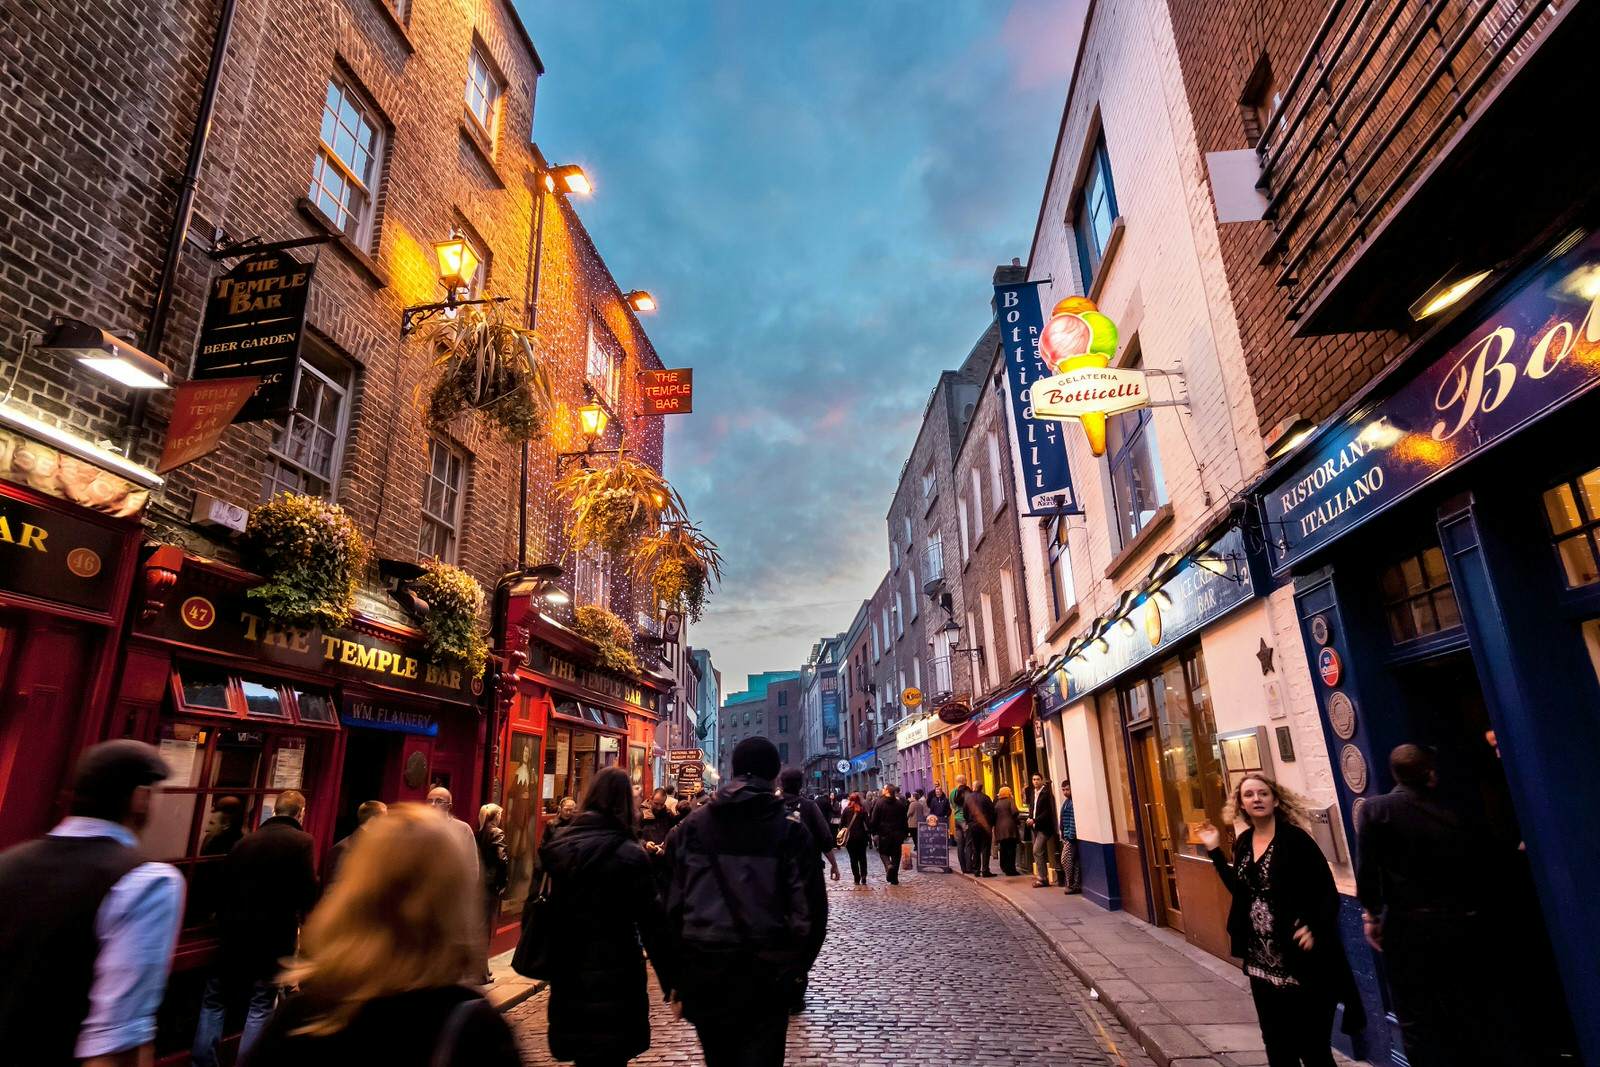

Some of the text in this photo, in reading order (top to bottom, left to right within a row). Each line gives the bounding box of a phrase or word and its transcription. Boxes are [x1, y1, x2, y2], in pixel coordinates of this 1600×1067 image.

[246, 259, 280, 273] THE
[217, 273, 307, 299] TEMPLE
[229, 294, 283, 315] BAR
[203, 333, 297, 355] BEER GARDEN
[655, 372, 678, 383] THE
[1058, 373, 1118, 387] GELATERIA
[645, 384, 691, 397] TEMPLE
[1003, 291, 1045, 488] Botticelli
[1043, 383, 1140, 404] Botticelli
[655, 398, 679, 409] BAR
[1300, 466, 1384, 538] ITALIANO
[73, 554, 95, 571] 46
[189, 605, 208, 621] 47
[320, 634, 418, 680] TEMPLE
[425, 663, 462, 690] BAR
[549, 656, 577, 682] THE
[624, 683, 641, 706] BAR
